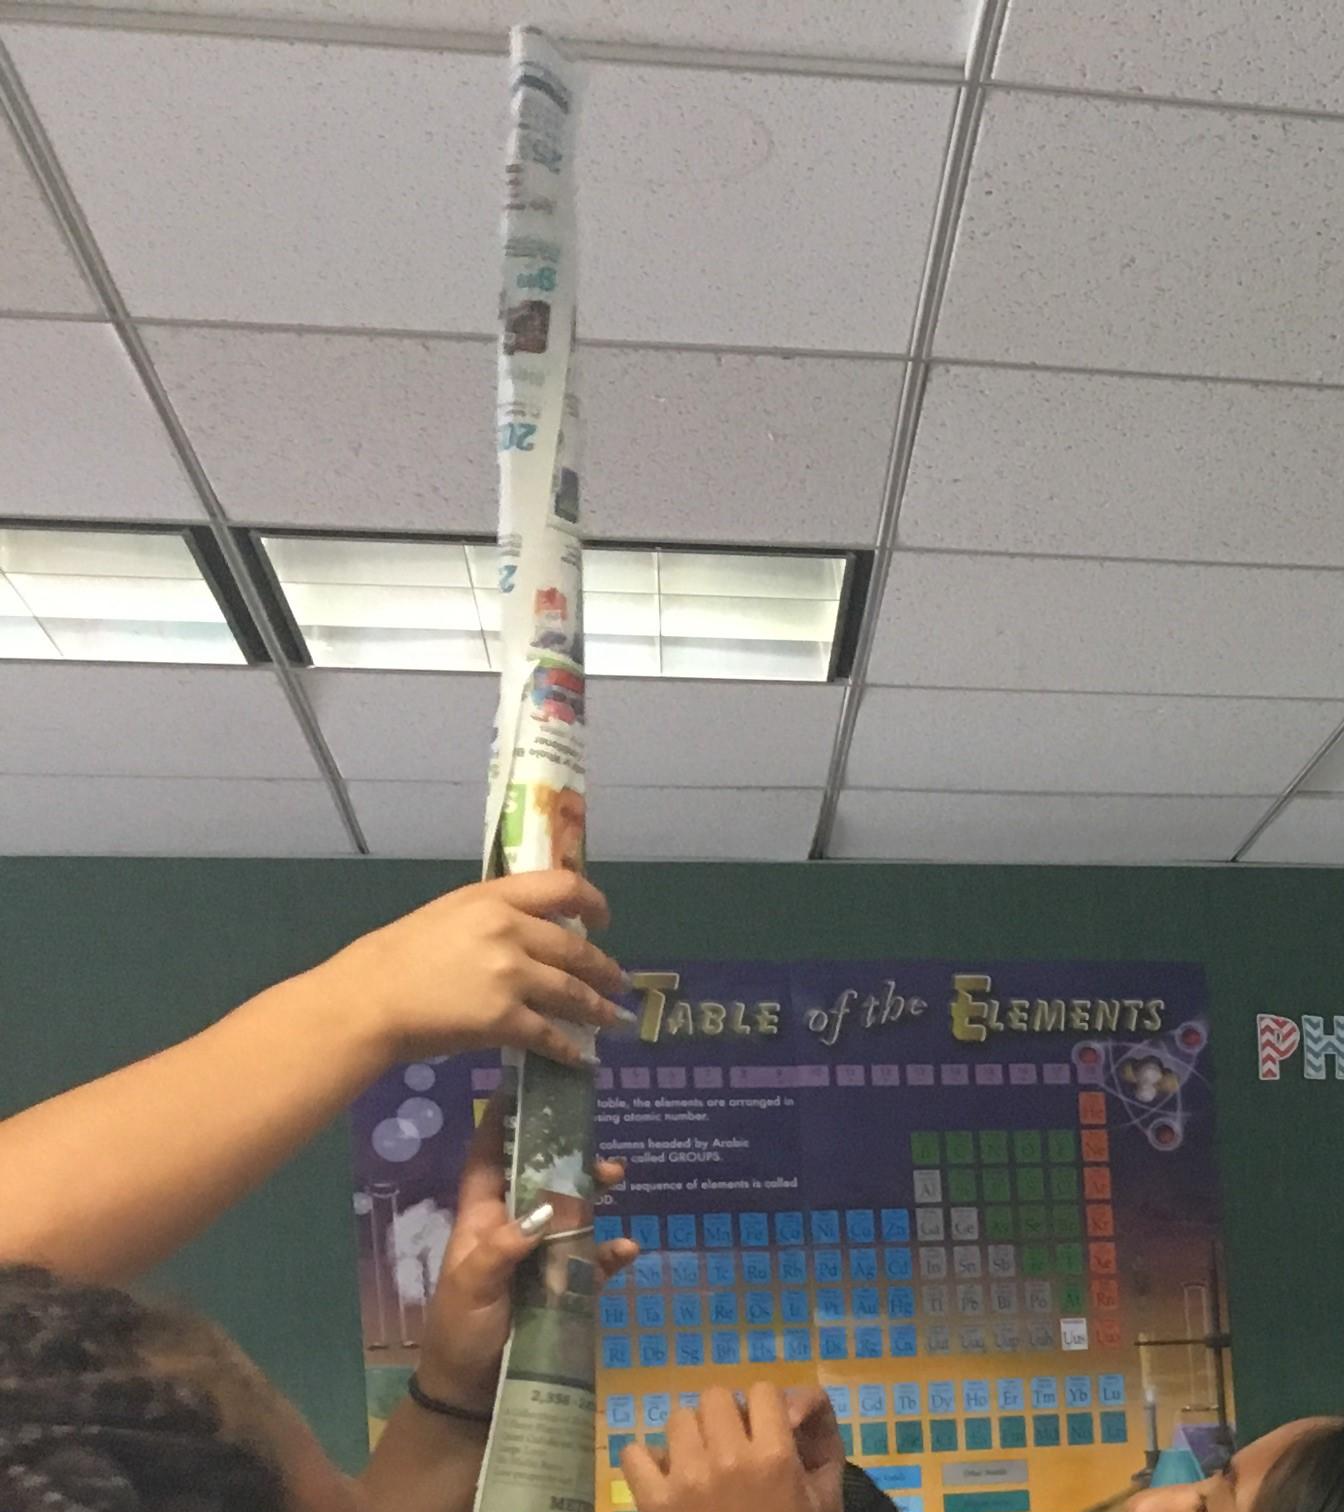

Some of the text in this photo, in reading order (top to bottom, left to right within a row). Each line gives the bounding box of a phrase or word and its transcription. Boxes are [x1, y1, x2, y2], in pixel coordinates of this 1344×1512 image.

[808, 989, 857, 1046] of
[863, 979, 928, 1028] the
[950, 974, 1165, 1043] ELEMENTS
[633, 1097, 651, 1108] the
[655, 1096, 703, 1108] elements
[706, 1099, 725, 1108] are
[729, 1096, 780, 1110] arranged
[623, 1112, 661, 1122] atomic
[599, 1137, 750, 1151] columns headed by Arabic
[630, 1152, 664, 1163] called
[630, 1181, 683, 1193] sequence
[701, 1179, 749, 1190] elements
[764, 1176, 798, 1189] called
